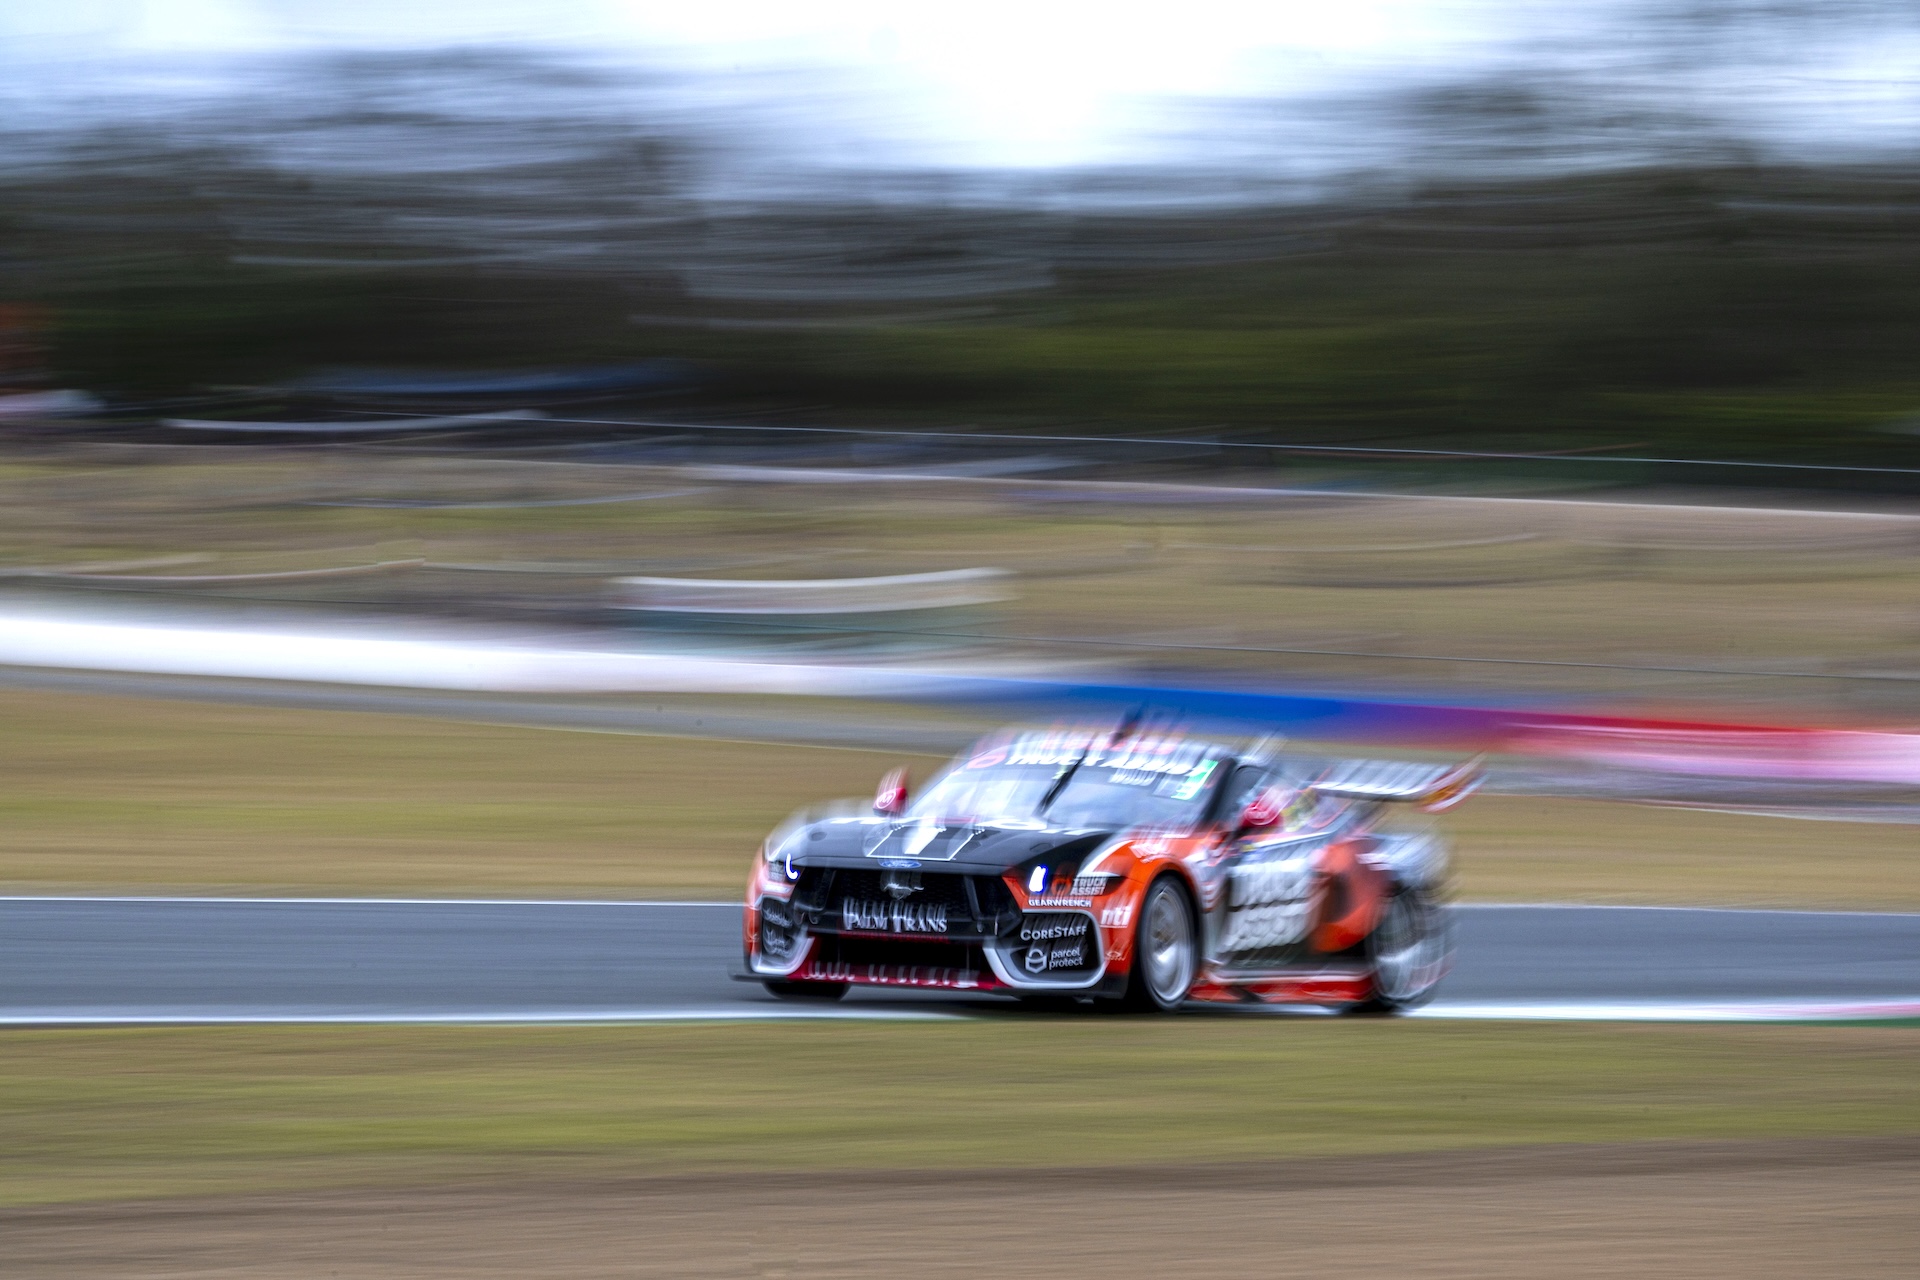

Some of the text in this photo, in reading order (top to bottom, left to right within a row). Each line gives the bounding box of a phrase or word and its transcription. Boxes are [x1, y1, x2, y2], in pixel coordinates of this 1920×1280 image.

[1073, 877, 1107, 887] TRUCK
[1070, 886, 1105, 896] ASSIST
[1028, 899, 1092, 908] GEARWRENCH
[843, 909, 948, 933] PALM TRANS
[1050, 947, 1080, 960] parcel
[1048, 957, 1083, 970] protect
